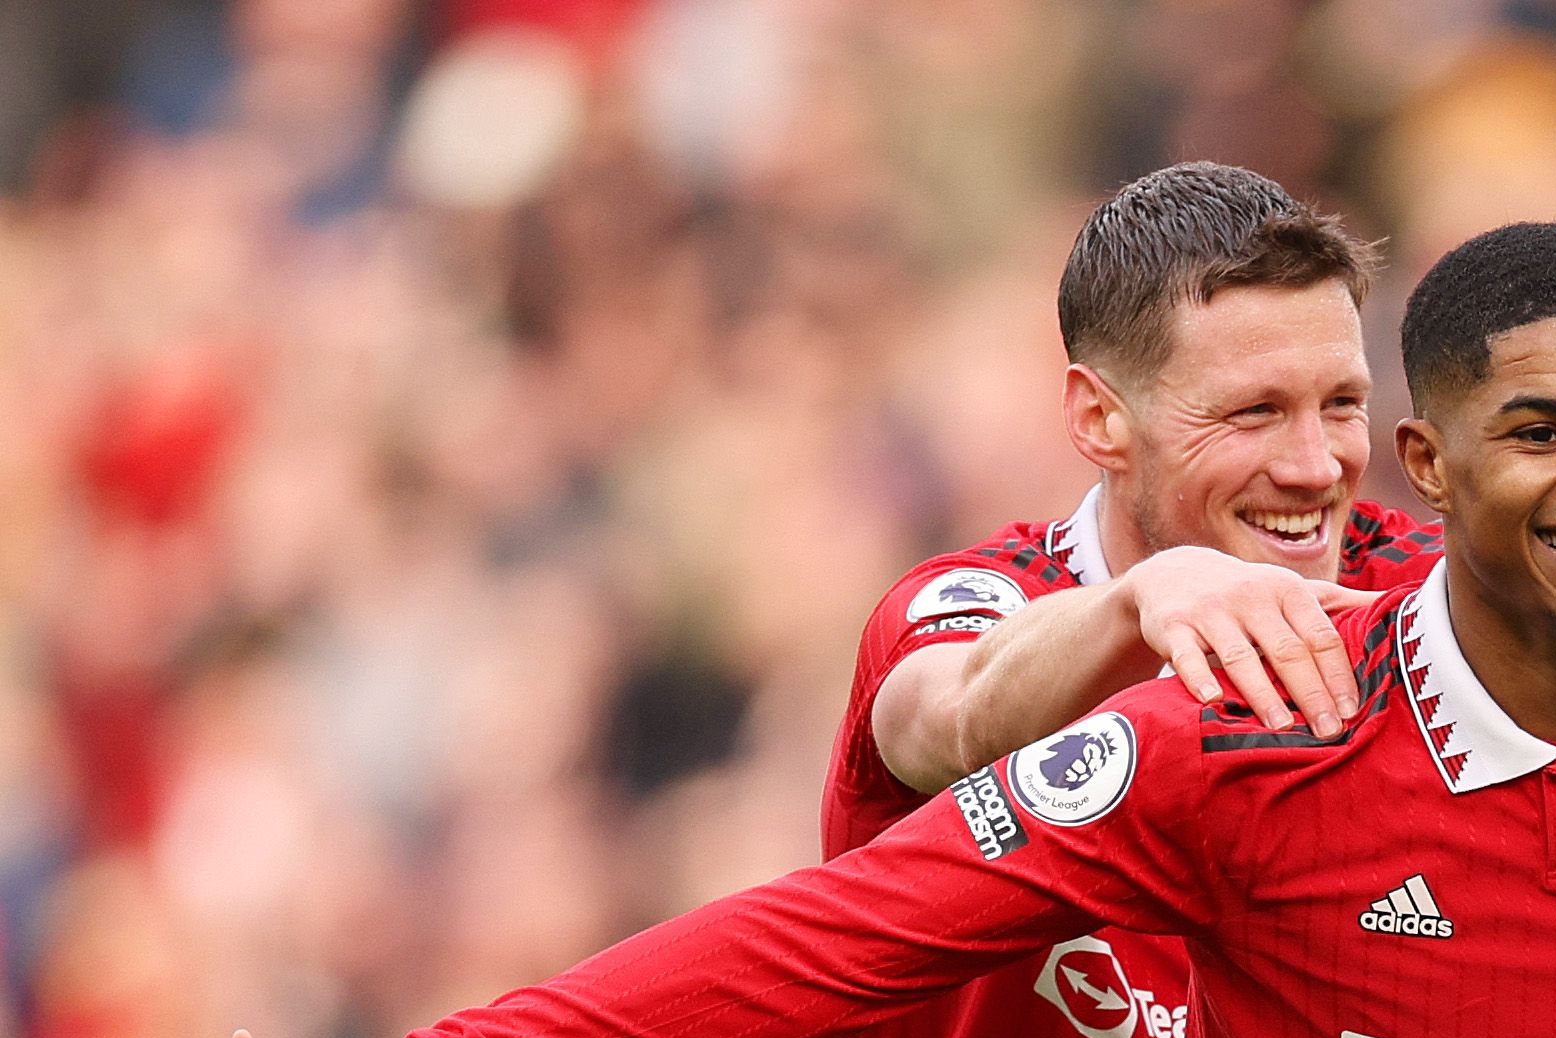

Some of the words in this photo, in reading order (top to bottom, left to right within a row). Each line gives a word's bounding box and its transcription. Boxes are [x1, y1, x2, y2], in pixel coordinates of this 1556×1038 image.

[973, 775, 1017, 841] room
[1024, 773, 1051, 804] Premier
[1051, 795, 1090, 812] League
[953, 784, 1003, 861] racism
[1360, 909, 1453, 938] adidas
